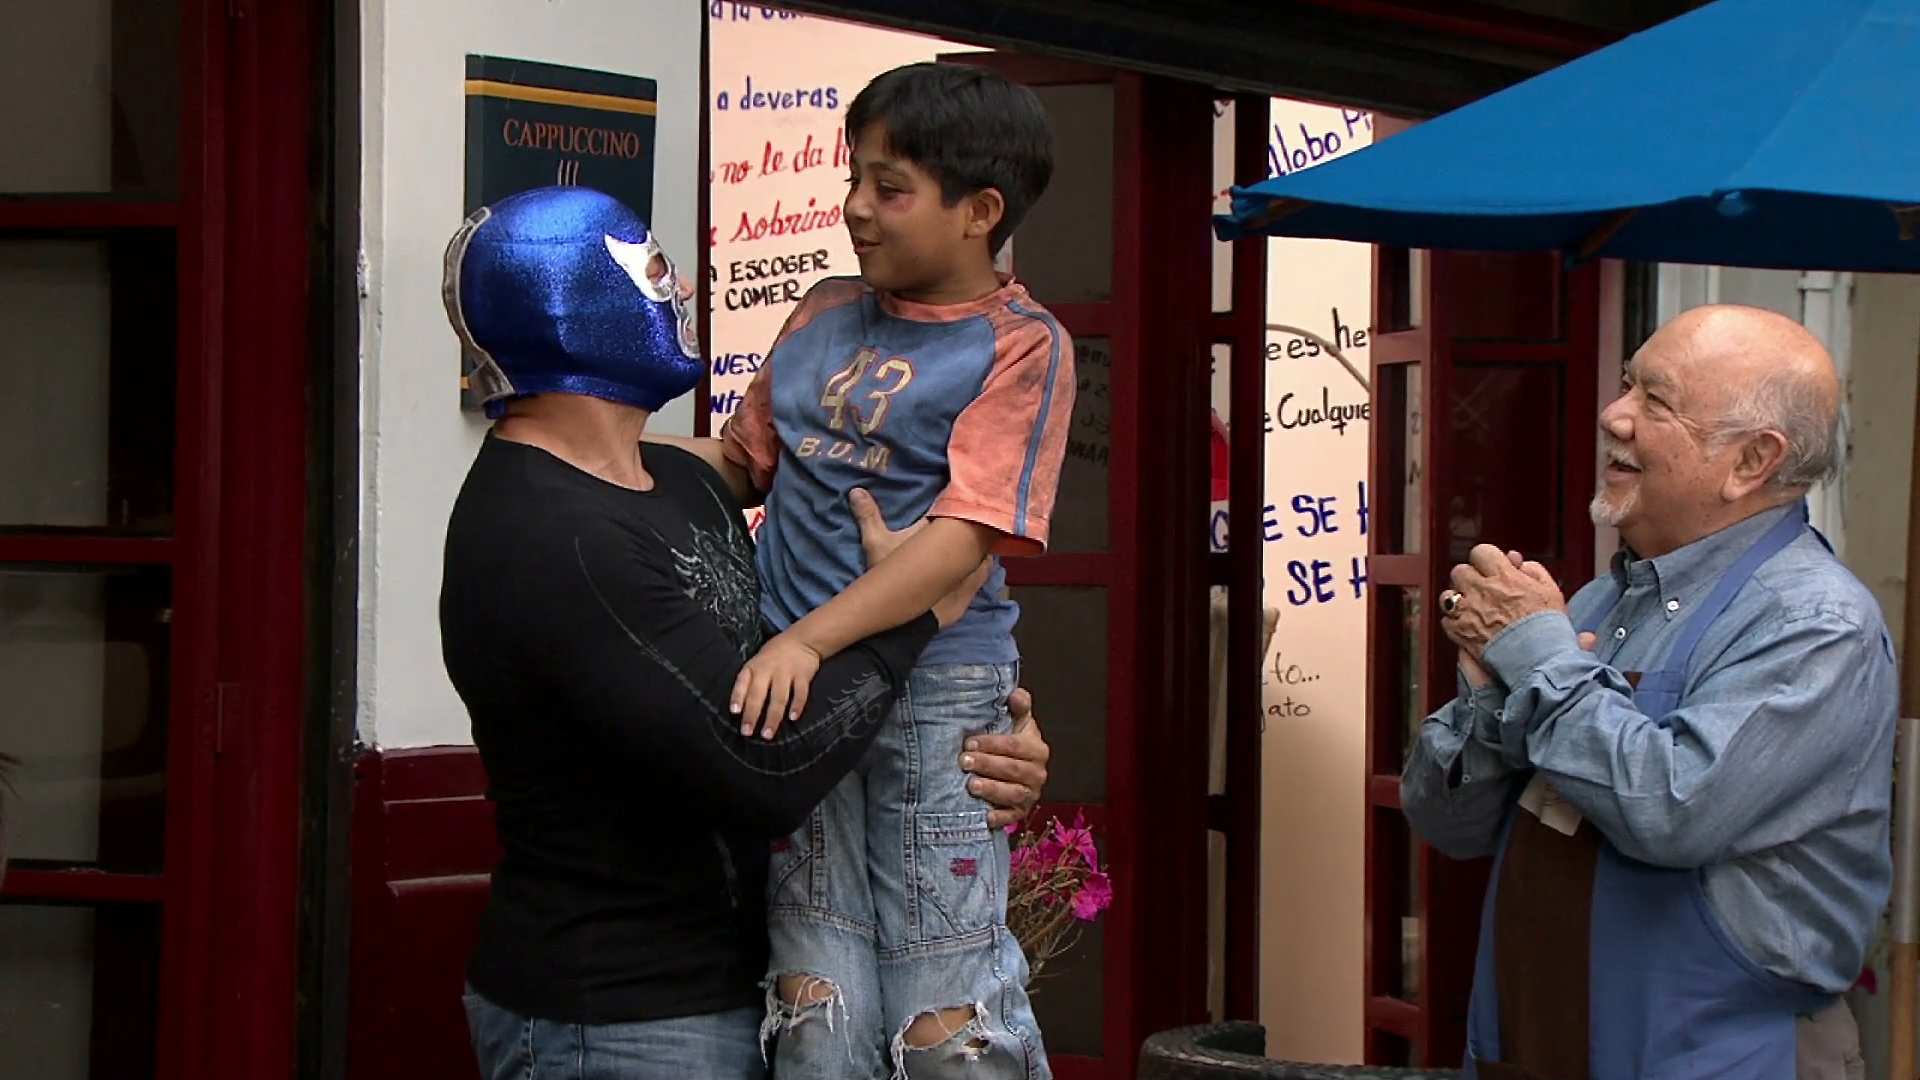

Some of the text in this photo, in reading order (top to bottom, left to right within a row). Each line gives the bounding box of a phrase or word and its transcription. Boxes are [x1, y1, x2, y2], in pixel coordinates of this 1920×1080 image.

[741, 75, 838, 110] deveras
[503, 118, 640, 160] CAPPUCCINO
[720, 160, 752, 185] no
[759, 141, 787, 178] le
[793, 134, 825, 173] da
[729, 197, 842, 243] sobrino
[729, 249, 830, 284] ESCOGER
[725, 279, 803, 311] COMER
[1333, 307, 1372, 352] he
[820, 348, 914, 436] 43
[1292, 494, 1339, 538] SE
[1287, 560, 1335, 606] SE
[1265, 695, 1311, 720] ato
